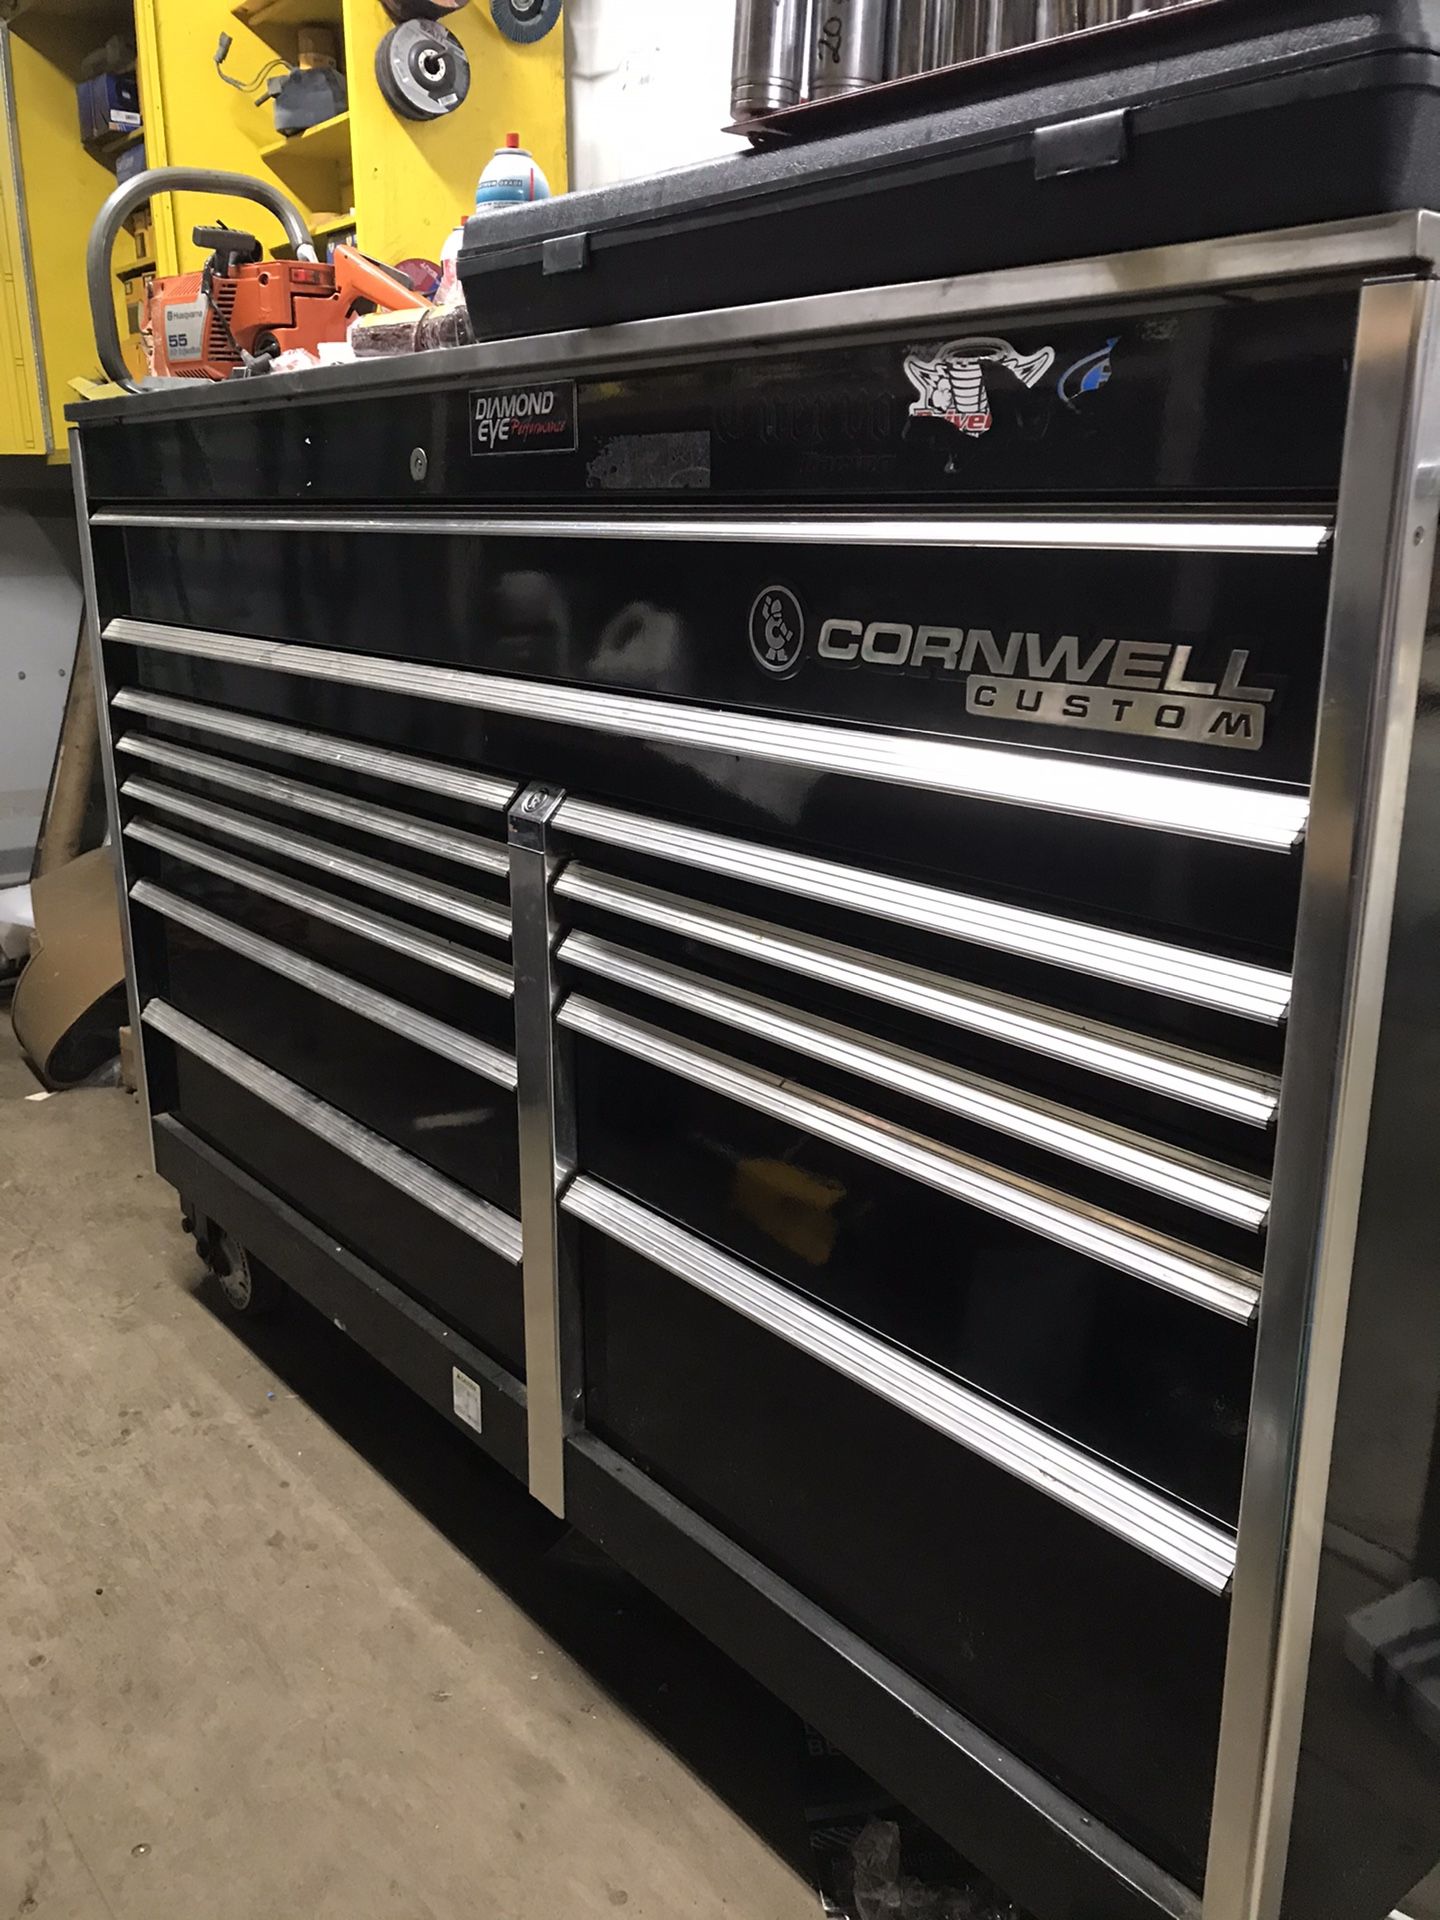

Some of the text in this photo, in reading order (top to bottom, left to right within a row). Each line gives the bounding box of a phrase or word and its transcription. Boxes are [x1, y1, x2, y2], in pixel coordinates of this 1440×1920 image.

[168, 334, 188, 347] 55
[475, 390, 554, 420] DIAMOND
[478, 418, 511, 449] EYE
[817, 618, 1275, 702] CORNWELL
[974, 684, 1252, 738] CUSTOM
